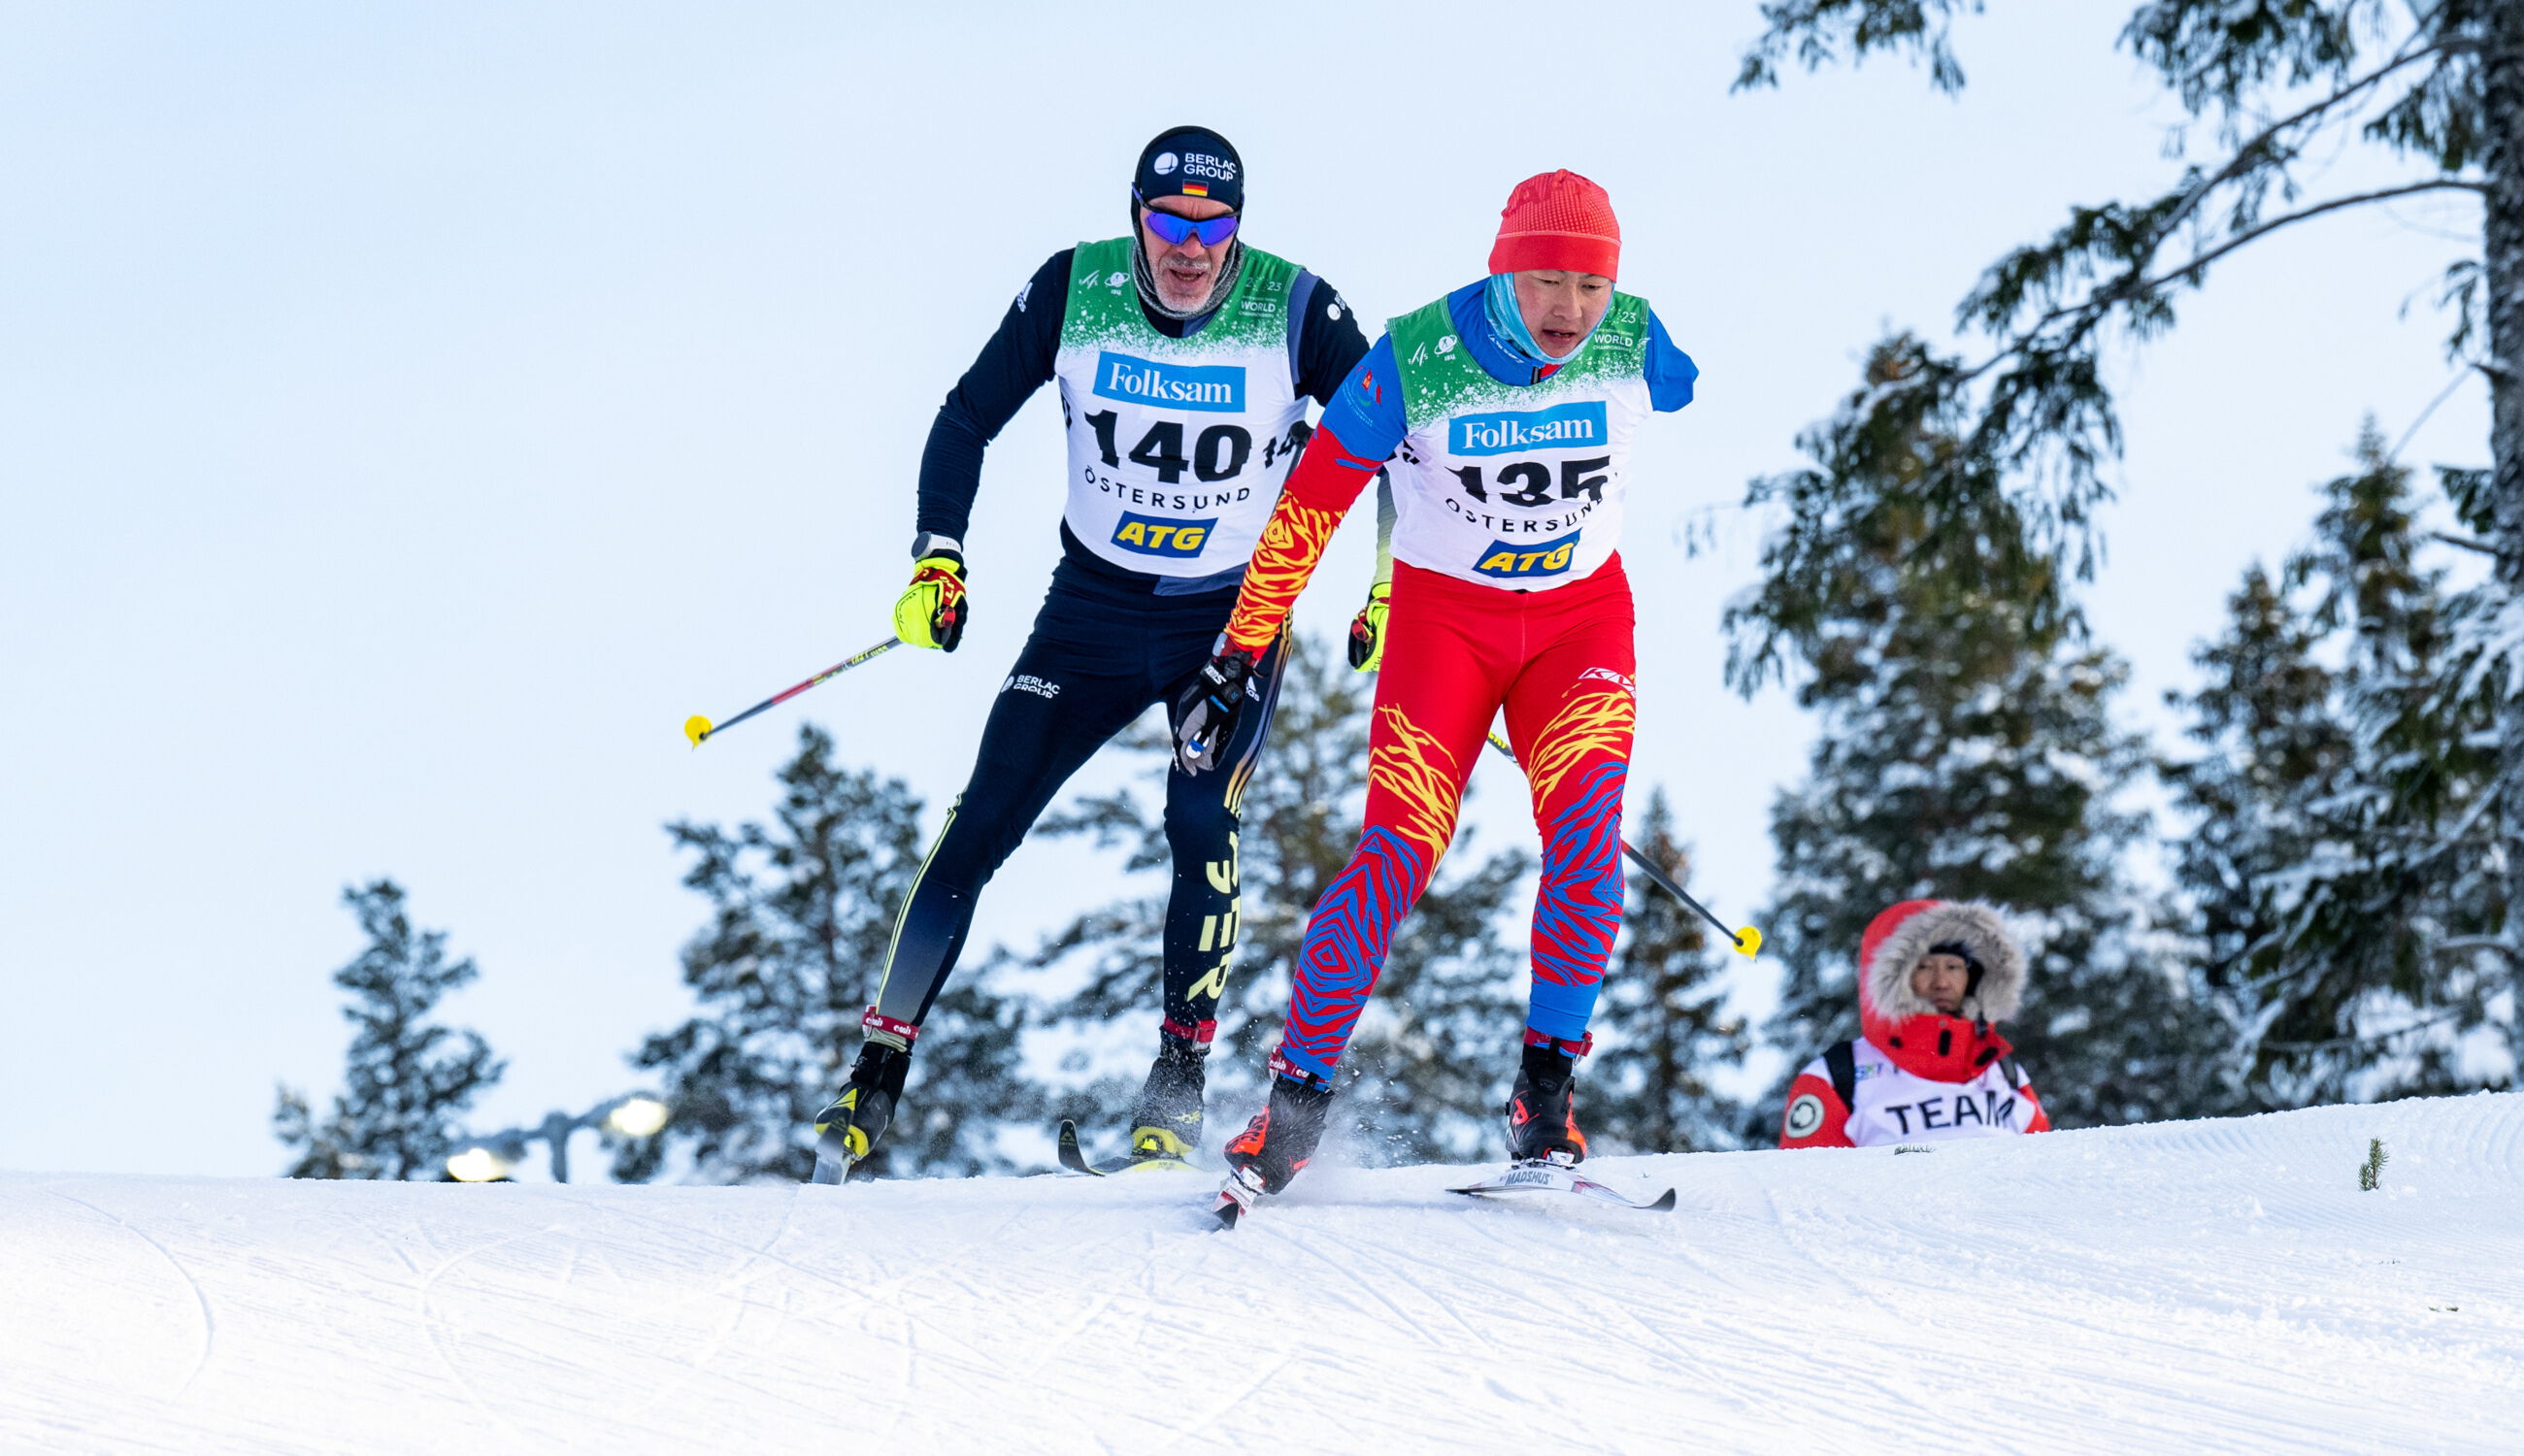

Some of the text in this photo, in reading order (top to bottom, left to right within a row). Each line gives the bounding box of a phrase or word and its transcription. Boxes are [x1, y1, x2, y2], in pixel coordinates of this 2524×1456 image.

[1183, 164, 1234, 182] GROUP
[1185, 152, 1237, 173] BERLAC
[1241, 301, 1276, 312] WORLD
[1594, 334, 1634, 347] WORLD
[1107, 362, 1232, 404] Folksam
[1083, 409, 1252, 484] 140
[1462, 417, 1594, 448] Folksam
[1084, 465, 1250, 510] ÖSTERSUND
[1445, 455, 1611, 508] 135
[1117, 521, 1207, 550] ATG
[1479, 543, 1575, 572] ATG
[1013, 683, 1053, 699] GROUP
[1016, 675, 1060, 694] BERLAC
[1885, 1089, 2016, 1136] TEAM
[1506, 1171, 1550, 1186] MADSHUS
